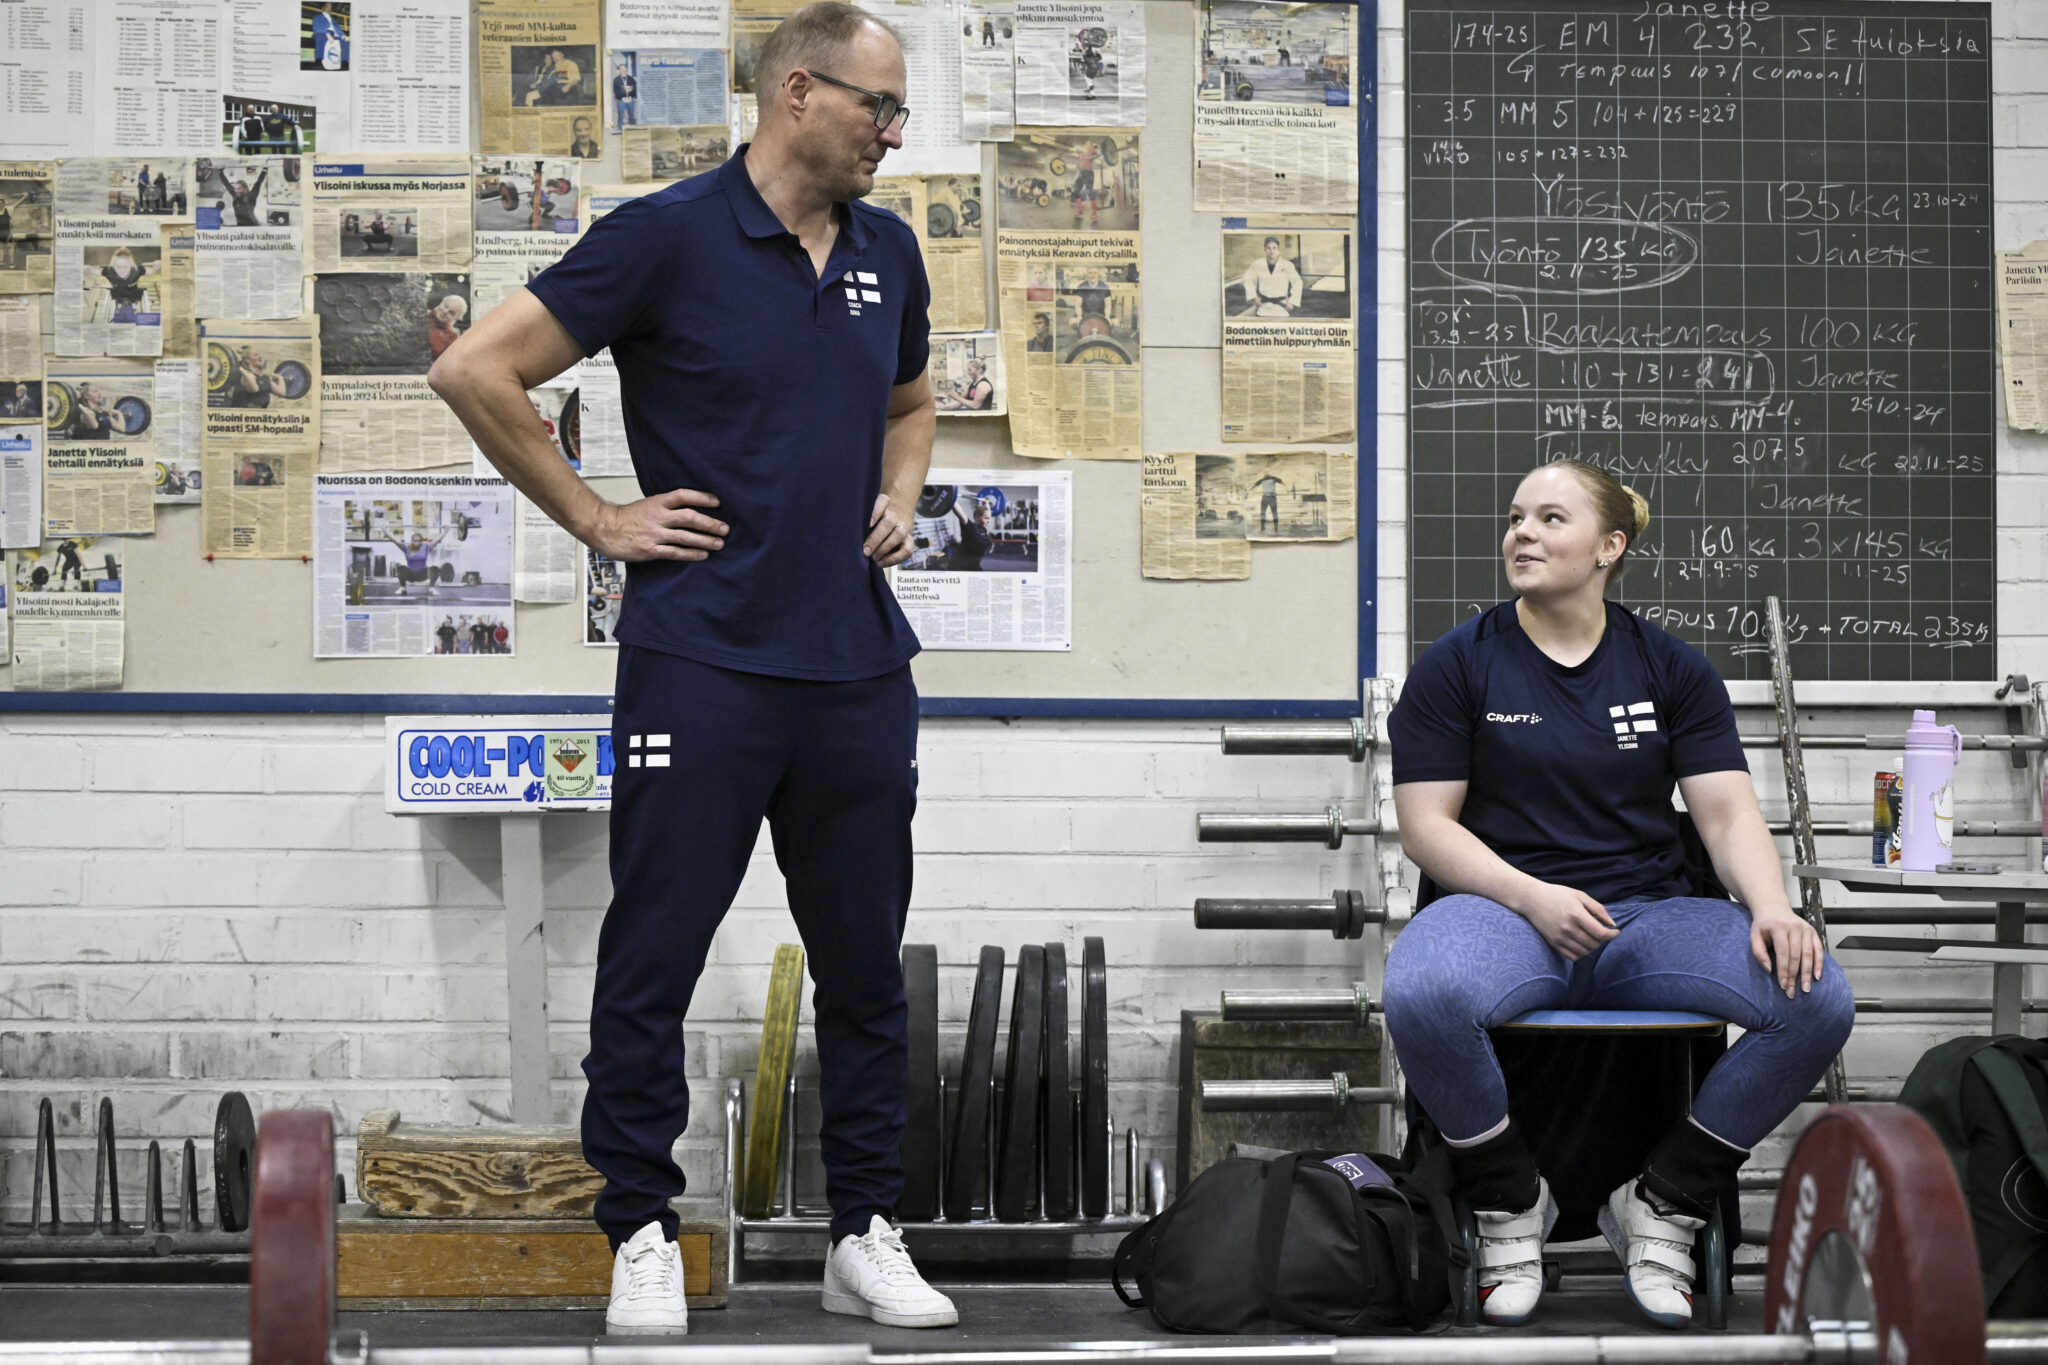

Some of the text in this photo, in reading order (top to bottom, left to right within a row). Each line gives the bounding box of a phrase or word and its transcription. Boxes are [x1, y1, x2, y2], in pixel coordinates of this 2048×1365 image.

[1016, 4, 1048, 13] Janette
[1083, 4, 1102, 14] jopa
[504, 22, 525, 31] nosti
[527, 22, 577, 31] MM-kultaa
[482, 34, 532, 43] veteraanien
[313, 180, 466, 193] Ylisoini iskussa myös Norjassa
[57, 219, 117, 231] Ylisoini palasi
[57, 230, 152, 241] ennätyksiä murskaten
[196, 232, 291, 244] Ylisoini palasi vahvana
[538, 238, 569, 246] nostaa
[999, 235, 1134, 249] Painonnostajahuiput tekivät
[475, 248, 484, 259] jo
[999, 247, 1138, 261] ennätyksiä Keravan citysalilla
[2005, 265, 2036, 274] Janette
[2005, 276, 2042, 285] Pariisiin
[1225, 326, 1348, 337] Bodonoksen Valtteri Olin
[1225, 337, 1351, 349] nimettiin huippuryhmään
[320, 381, 381, 391] lympialaiset
[383, 381, 393, 392] jo
[354, 391, 377, 401] 2024
[380, 391, 402, 401] kisat
[207, 413, 311, 425] Ylisoini ennätyksiin ja
[207, 424, 304, 435] upeasti SM-hopealle
[47, 447, 127, 458] Janette Ylisoini
[47, 457, 144, 469] tehtaili ennätyksiä
[1144, 455, 1175, 467] Kyyrö
[1144, 466, 1178, 476] tarttui
[318, 475, 367, 486] Nuorissa
[369, 477, 381, 485] on
[1143, 477, 1187, 487] tankoon
[897, 576, 920, 584] Rauta
[932, 577, 961, 585] kevyttä
[16, 597, 120, 609] Ylisoini nosti Kalajoella
[16, 608, 121, 619] uudelle kymmenluvulle
[1839, 615, 1918, 638] TOTAL
[1486, 712, 1530, 723] CRAFT
[409, 734, 617, 778] COOL-POR
[411, 782, 508, 796] COLD CREAM
